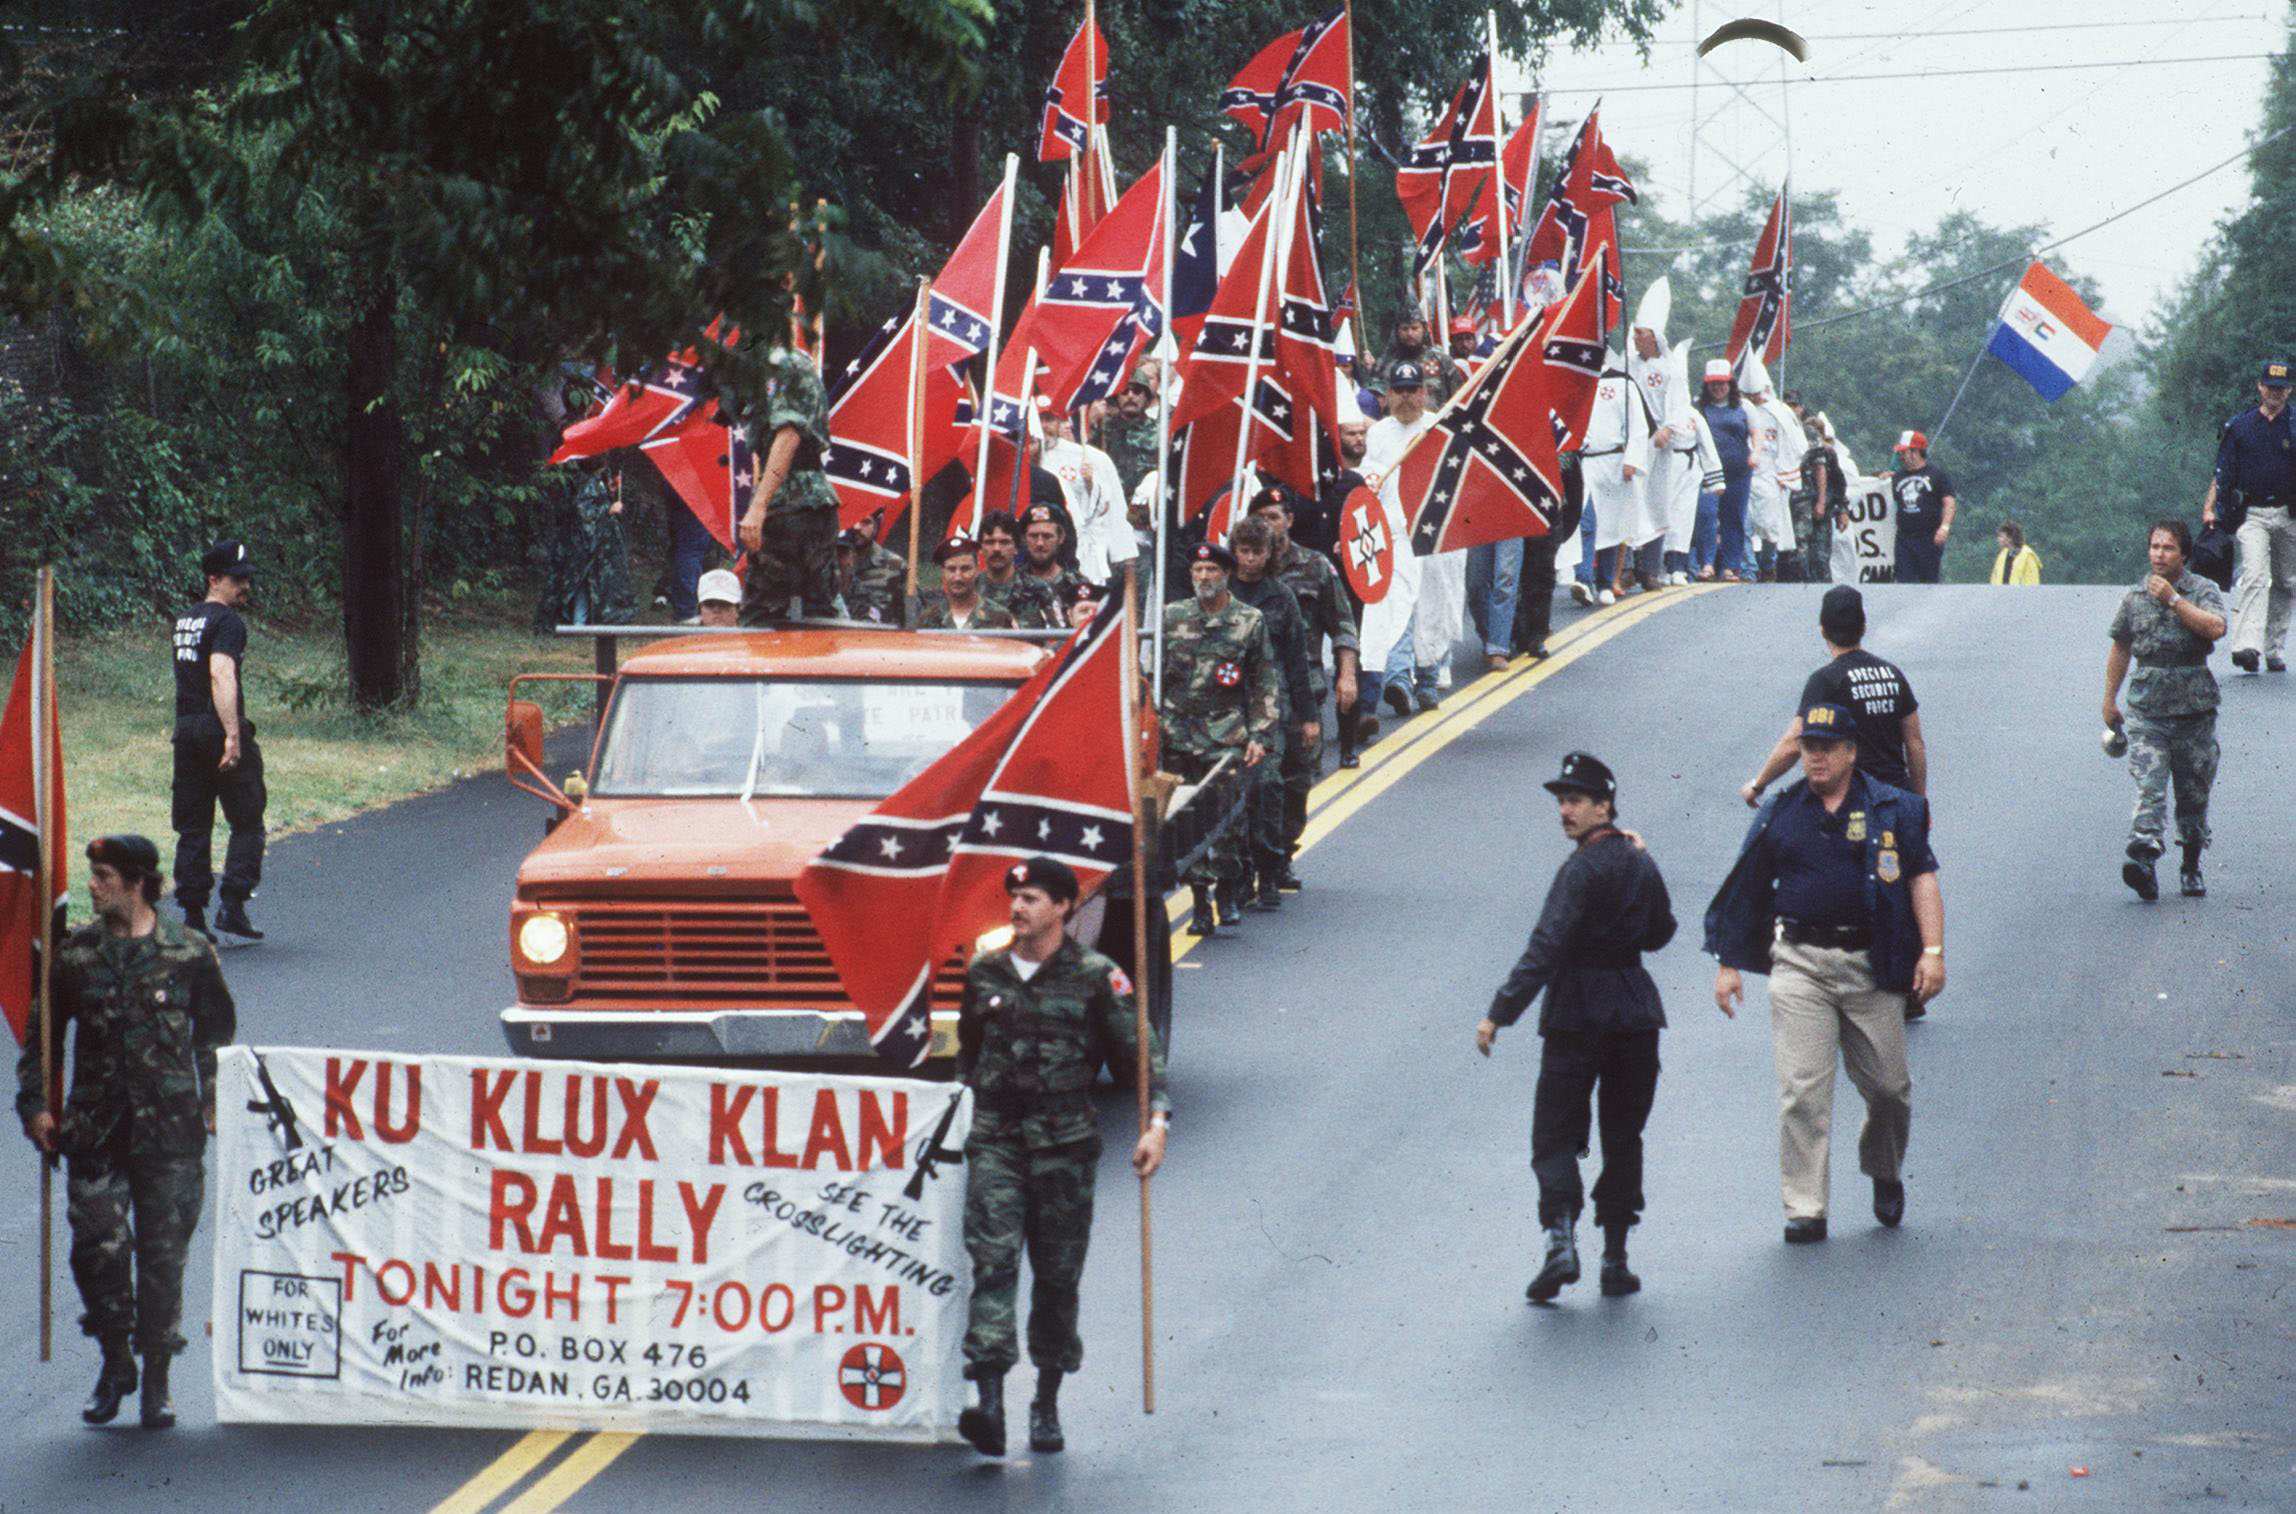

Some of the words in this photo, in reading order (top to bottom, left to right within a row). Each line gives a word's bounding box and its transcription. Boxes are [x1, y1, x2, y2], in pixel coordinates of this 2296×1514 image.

[1847, 666, 1895, 683] SPECIAL
[1851, 681, 1900, 700] SECURITY
[1865, 698, 1895, 715] FORCE
[325, 1057, 421, 1144] KU
[471, 1067, 660, 1162] KLUX
[708, 1082, 908, 1172] KLAN
[250, 1145, 335, 1195] GREAT
[255, 1166, 410, 1240] SPEAKERS
[488, 1167, 727, 1265] RALLY
[817, 1182, 872, 1213] SEE
[879, 1204, 933, 1242] THE
[273, 1278, 309, 1299] FOR
[331, 1251, 632, 1325] TONIGHT
[665, 1278, 796, 1334] 7:00
[812, 1283, 916, 1337] P.M.
[246, 1307, 335, 1334] WHITES
[371, 1318, 410, 1345] For
[263, 1338, 314, 1360] ONLY
[383, 1342, 441, 1368] More
[489, 1331, 547, 1359] P.O.
[561, 1337, 627, 1364] BOX
[643, 1343, 707, 1369] 476
[647, 1377, 750, 1404] 30004
